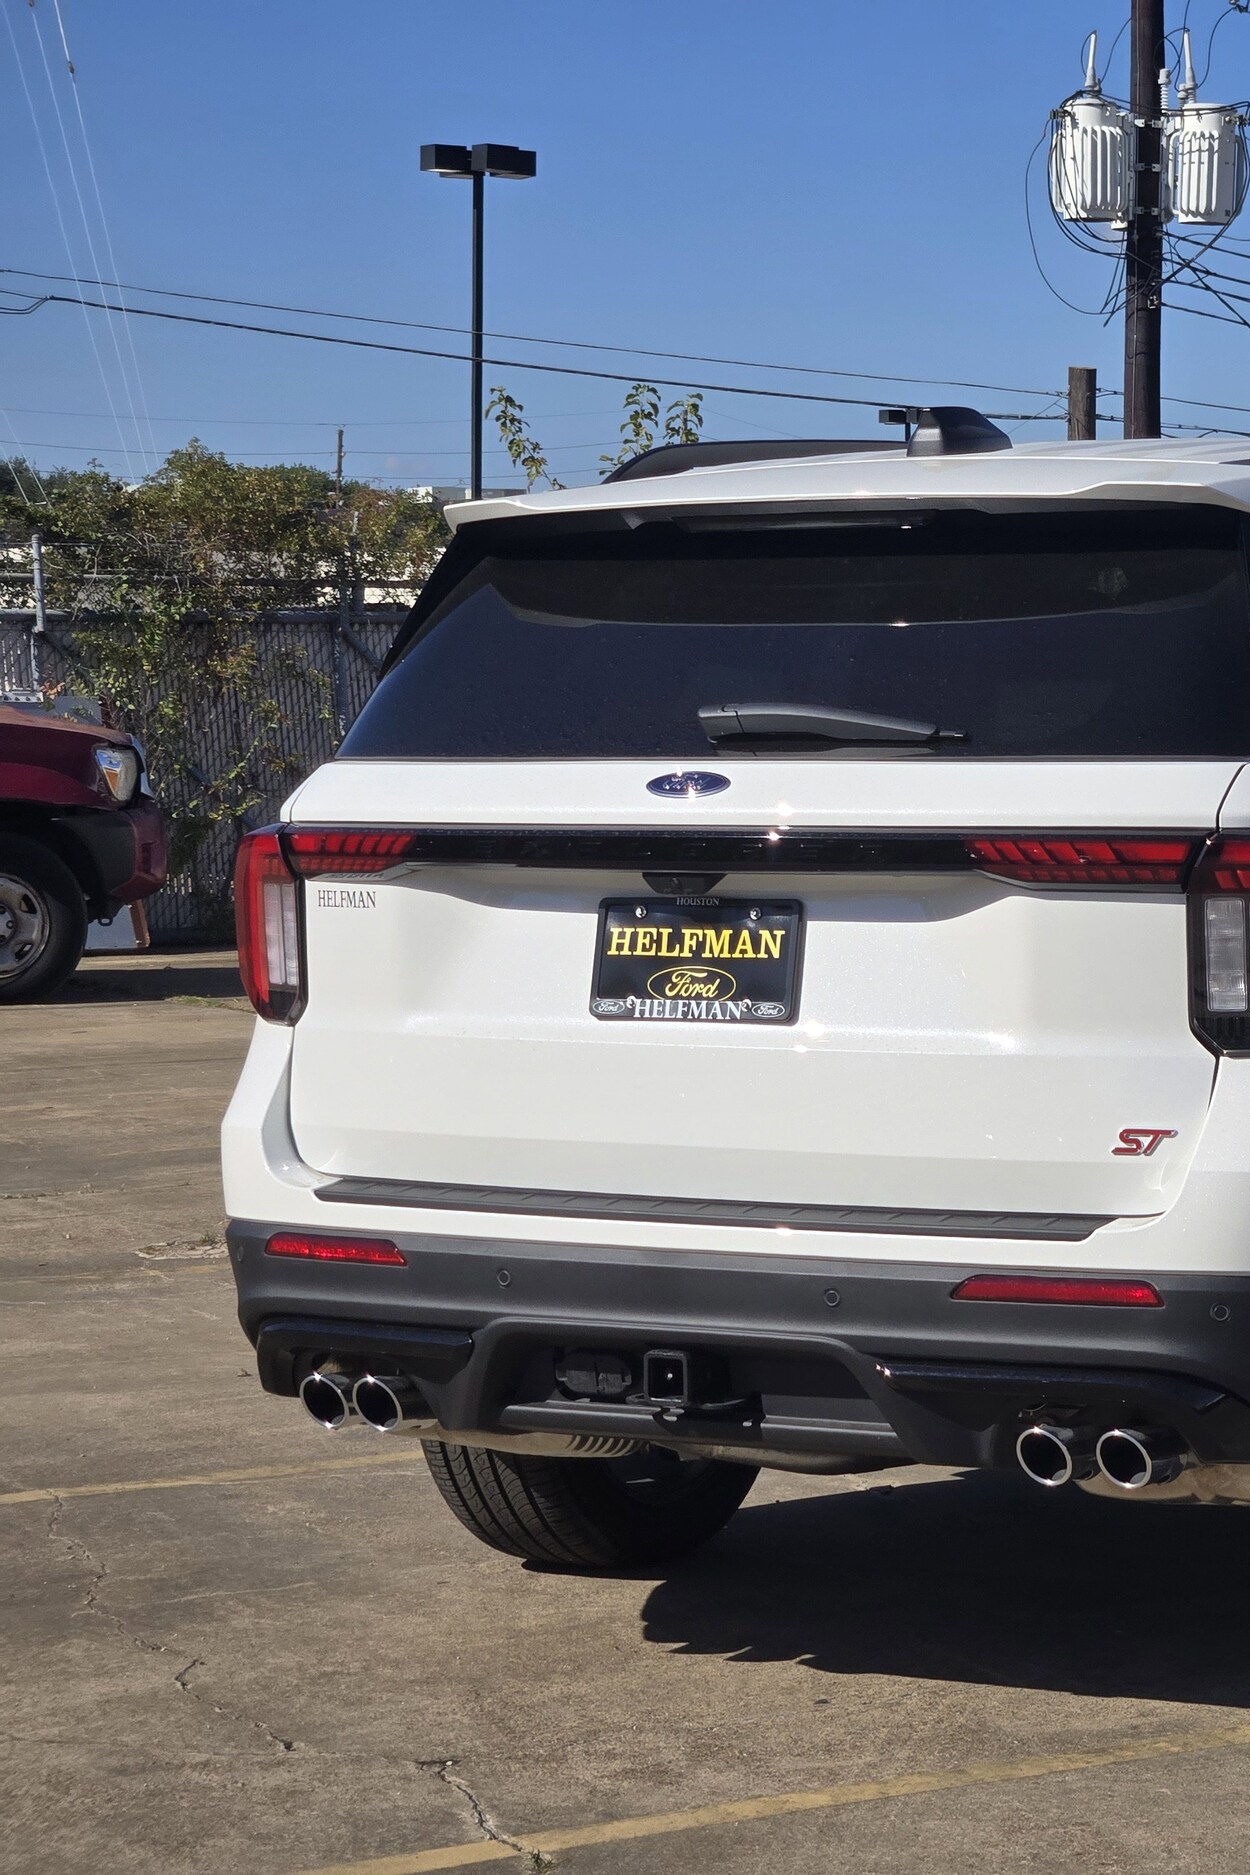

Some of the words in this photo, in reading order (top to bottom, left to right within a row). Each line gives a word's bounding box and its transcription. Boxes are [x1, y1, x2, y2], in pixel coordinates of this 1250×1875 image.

[317, 889, 376, 909] HELFMAN
[676, 897, 720, 906] HOUSTON
[607, 927, 786, 959] HELFMAN
[664, 970, 721, 998] Ford
[598, 1001, 620, 1012] Ford
[633, 998, 744, 1020] HELFMAN
[757, 1004, 780, 1016] Ford
[1111, 1128, 1179, 1157] ST
